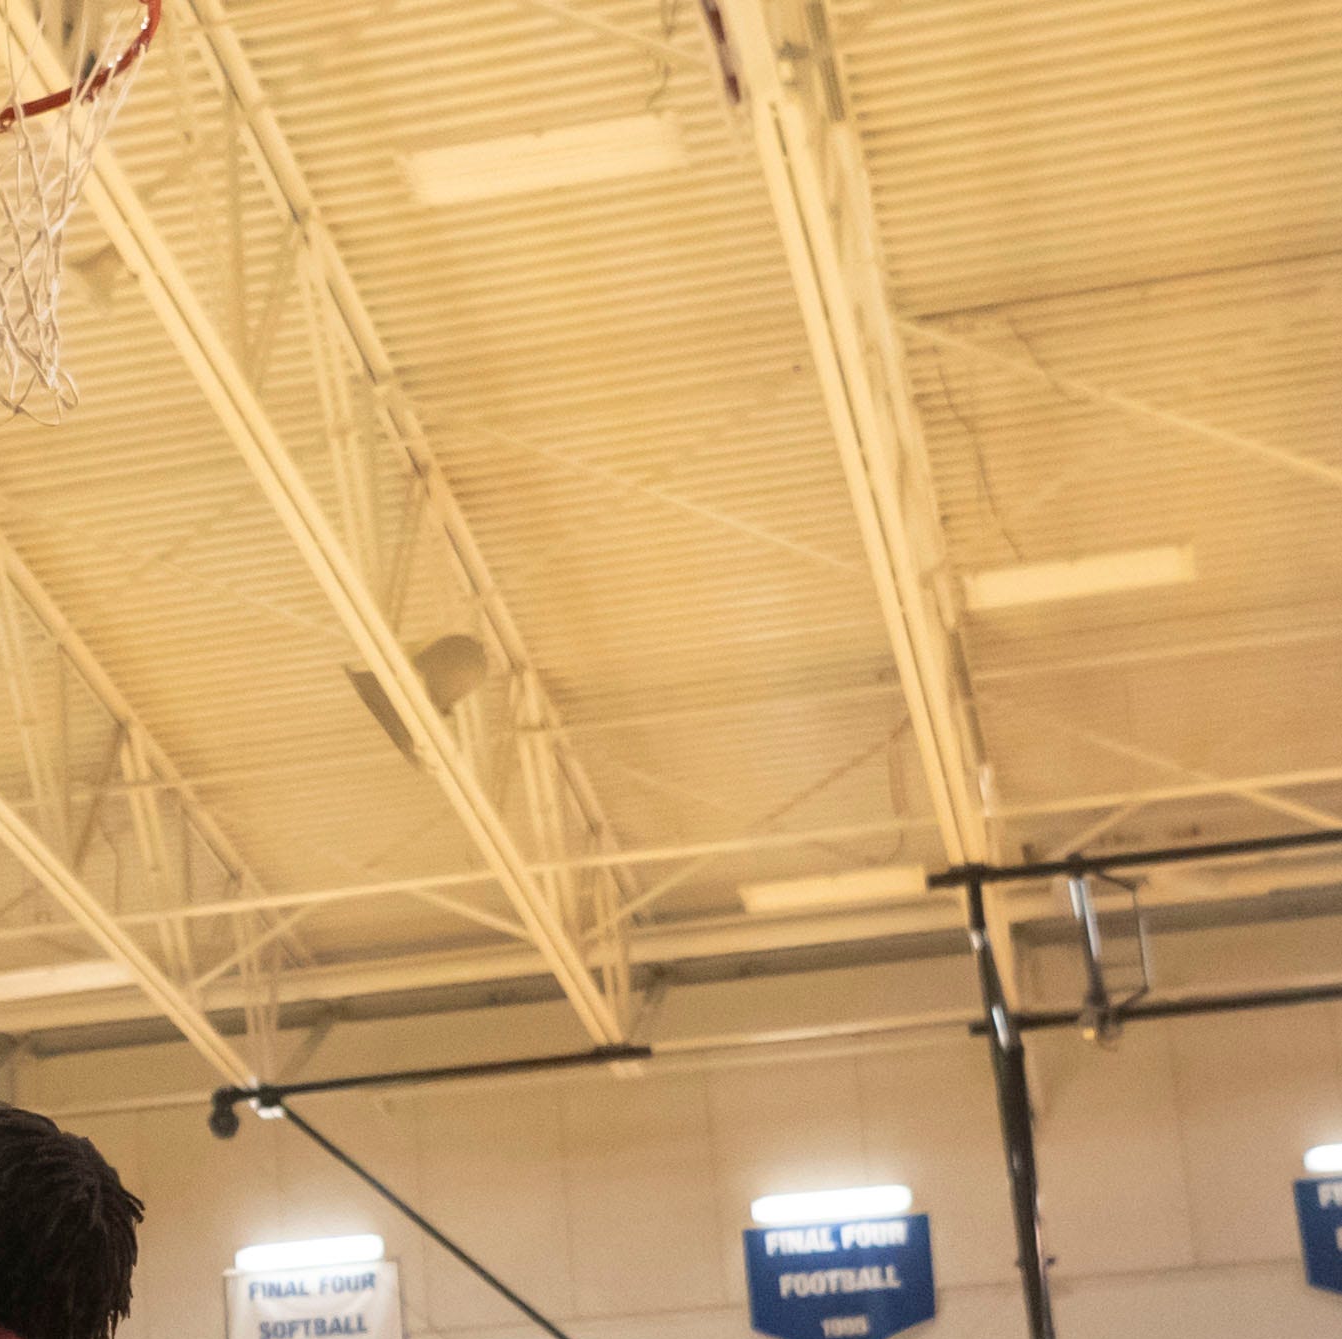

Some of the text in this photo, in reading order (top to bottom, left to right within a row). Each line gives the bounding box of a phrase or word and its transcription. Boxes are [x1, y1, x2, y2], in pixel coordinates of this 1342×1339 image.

[765, 1220, 907, 1256] FINAL FOUR
[249, 1272, 376, 1300] FINAL FOUR
[779, 1265, 901, 1299] FOOTBALL
